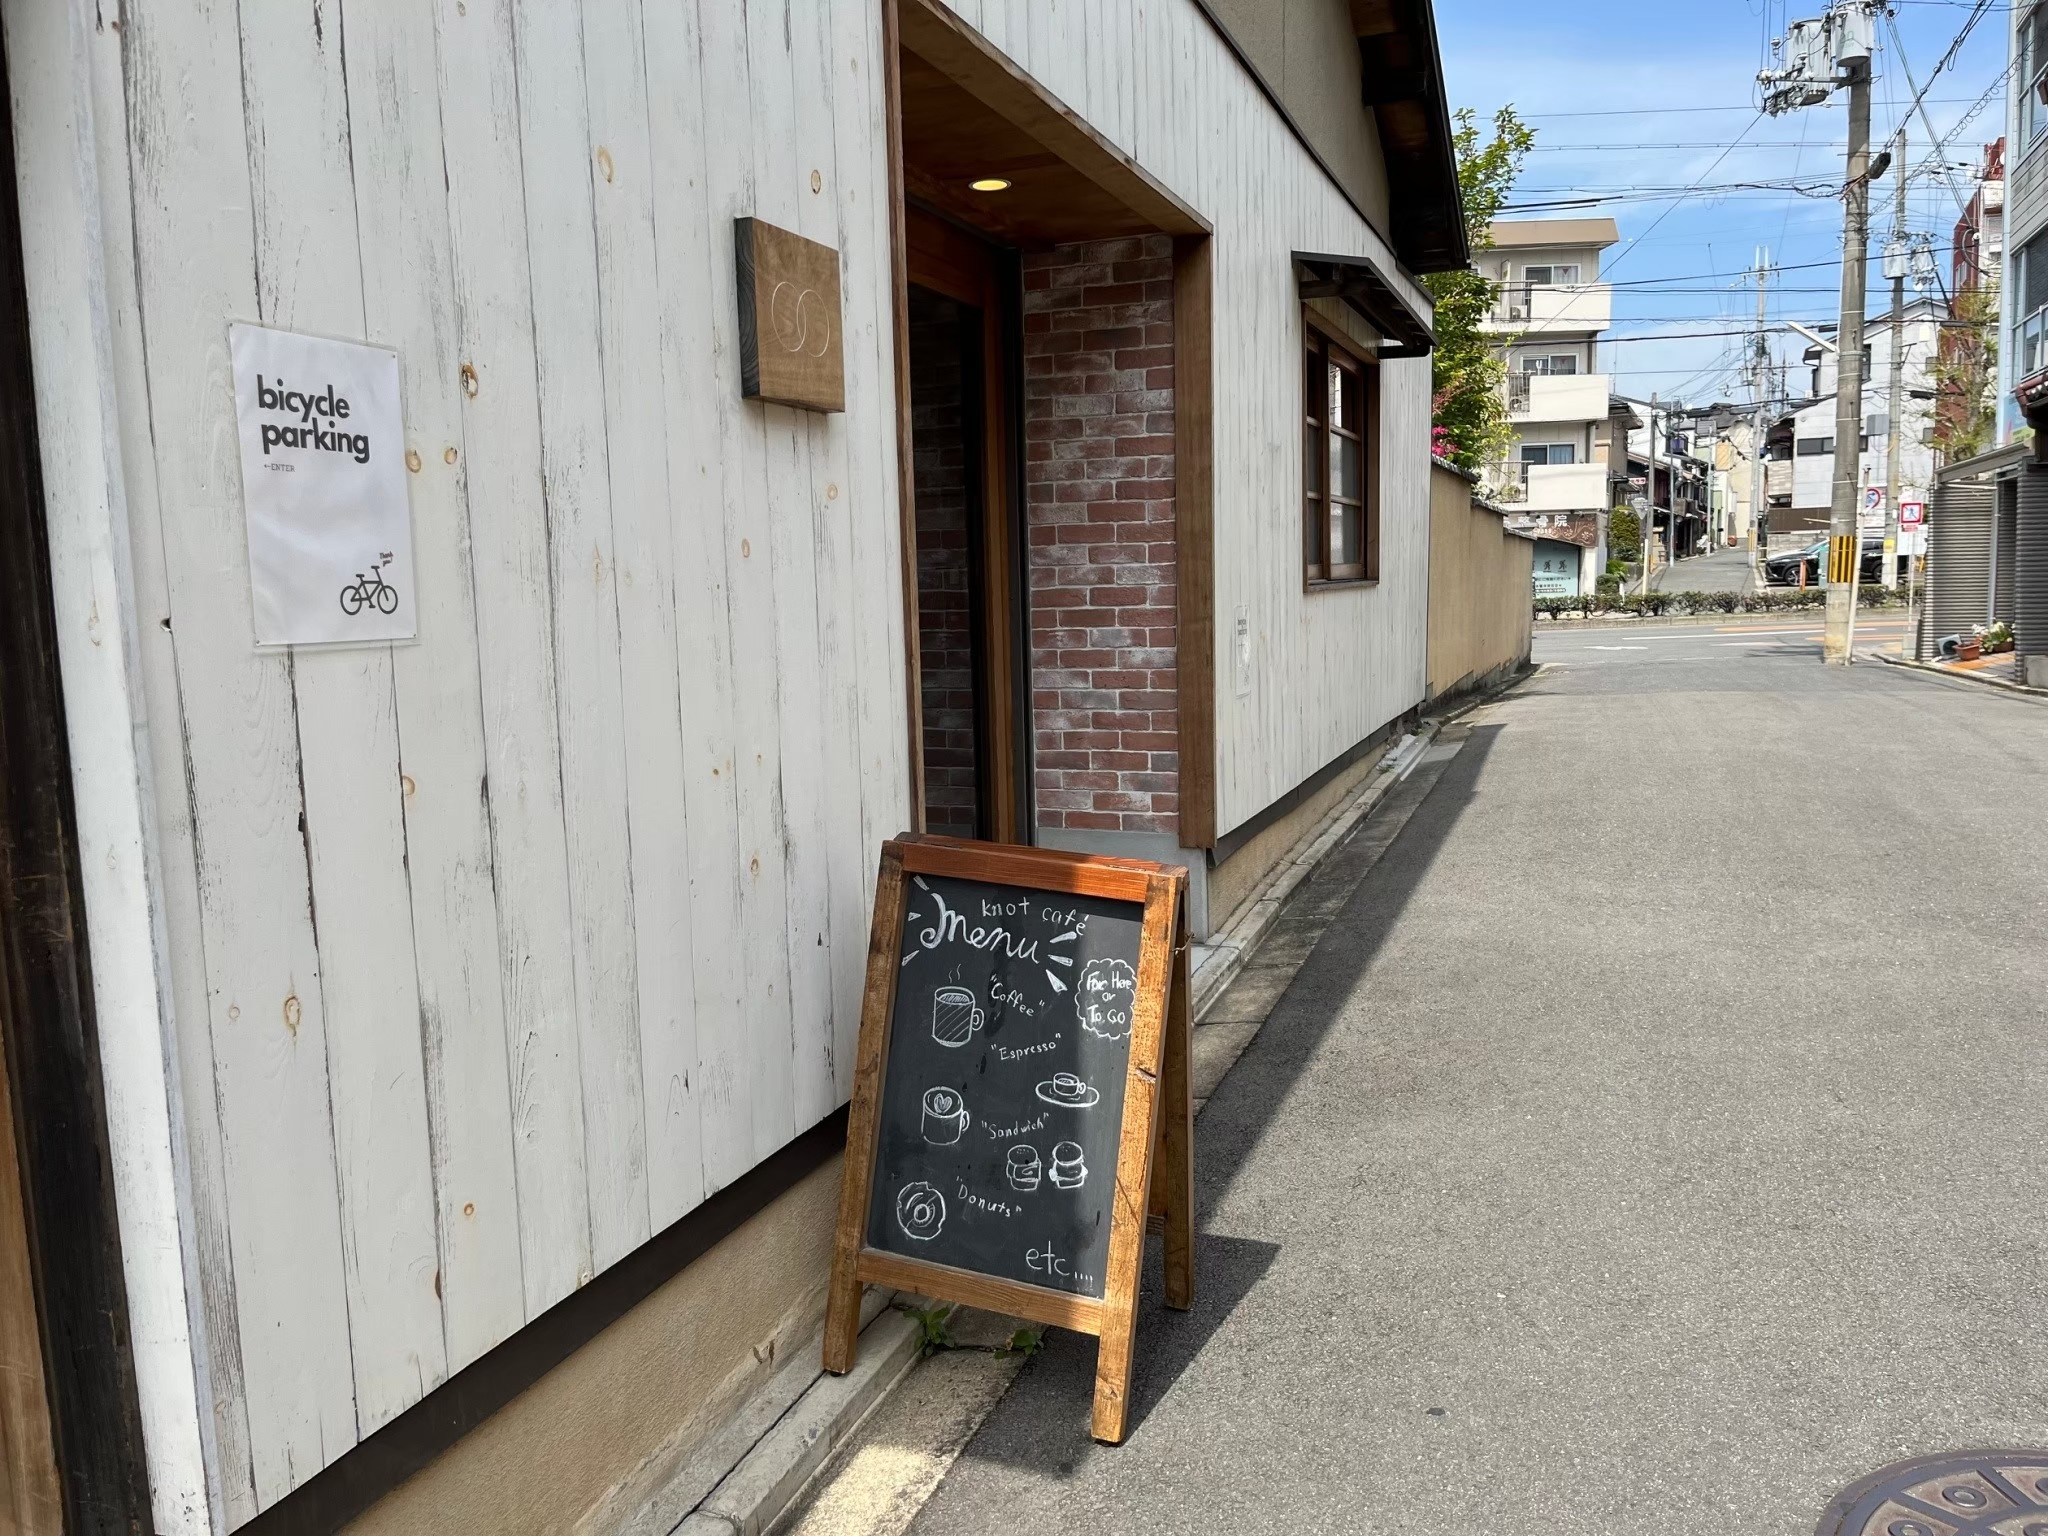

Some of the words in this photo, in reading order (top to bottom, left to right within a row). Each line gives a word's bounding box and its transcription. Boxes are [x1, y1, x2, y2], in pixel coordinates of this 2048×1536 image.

[257, 374, 350, 423] bicycle
[261, 417, 370, 464] parking
[271, 463, 295, 472] ENTER
[920, 892, 1040, 964] Menu
[982, 896, 1030, 917] knot
[1042, 907, 1089, 936] café
[1102, 992, 1116, 1002] or
